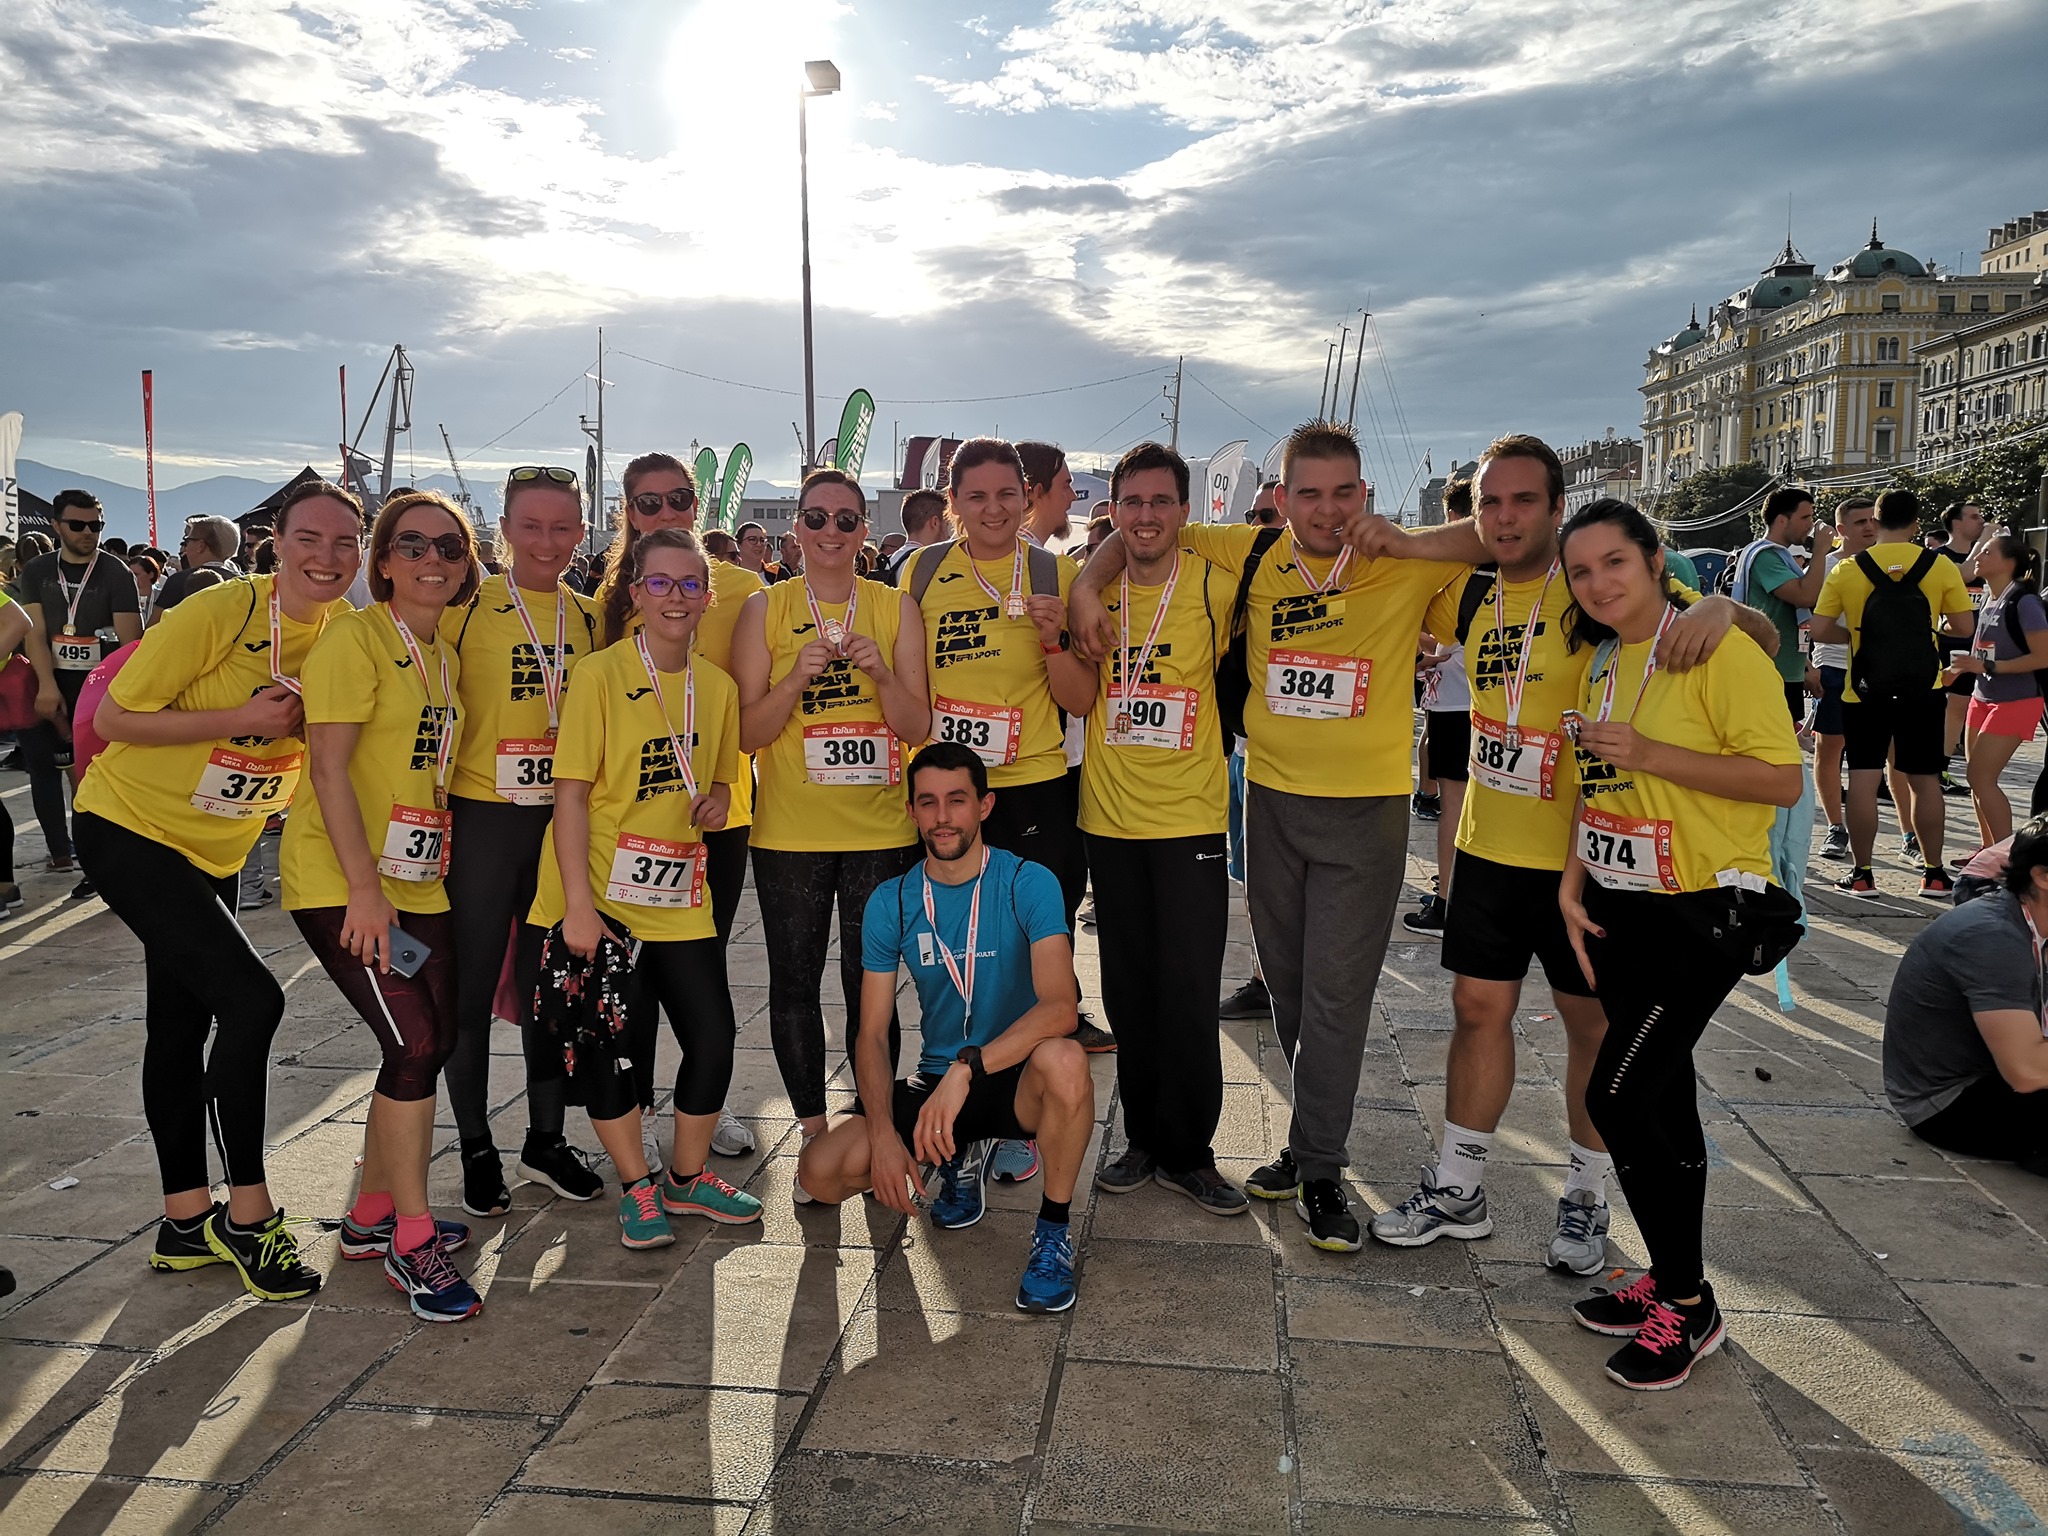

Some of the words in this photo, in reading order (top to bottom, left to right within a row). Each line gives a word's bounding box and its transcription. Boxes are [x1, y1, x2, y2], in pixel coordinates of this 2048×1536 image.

[847, 402, 873, 480] RAWE
[727, 454, 752, 520] GRAWE
[5, 476, 18, 535] MIN
[18, 515, 51, 527] RMIN
[1315, 618, 1344, 631] SPORT
[59, 645, 91, 660] 495
[974, 649, 1001, 660] SPORT
[1134, 687, 1150, 696] Run
[1280, 668, 1335, 700] 384
[940, 715, 990, 747] 383
[823, 739, 876, 766] 380
[1477, 735, 1523, 774] 387
[516, 757, 555, 786] 38
[676, 781, 699, 792] SPT
[220, 773, 283, 801] 373
[405, 829, 443, 860] 378
[1586, 830, 1637, 870] 374
[631, 856, 687, 888] 377
